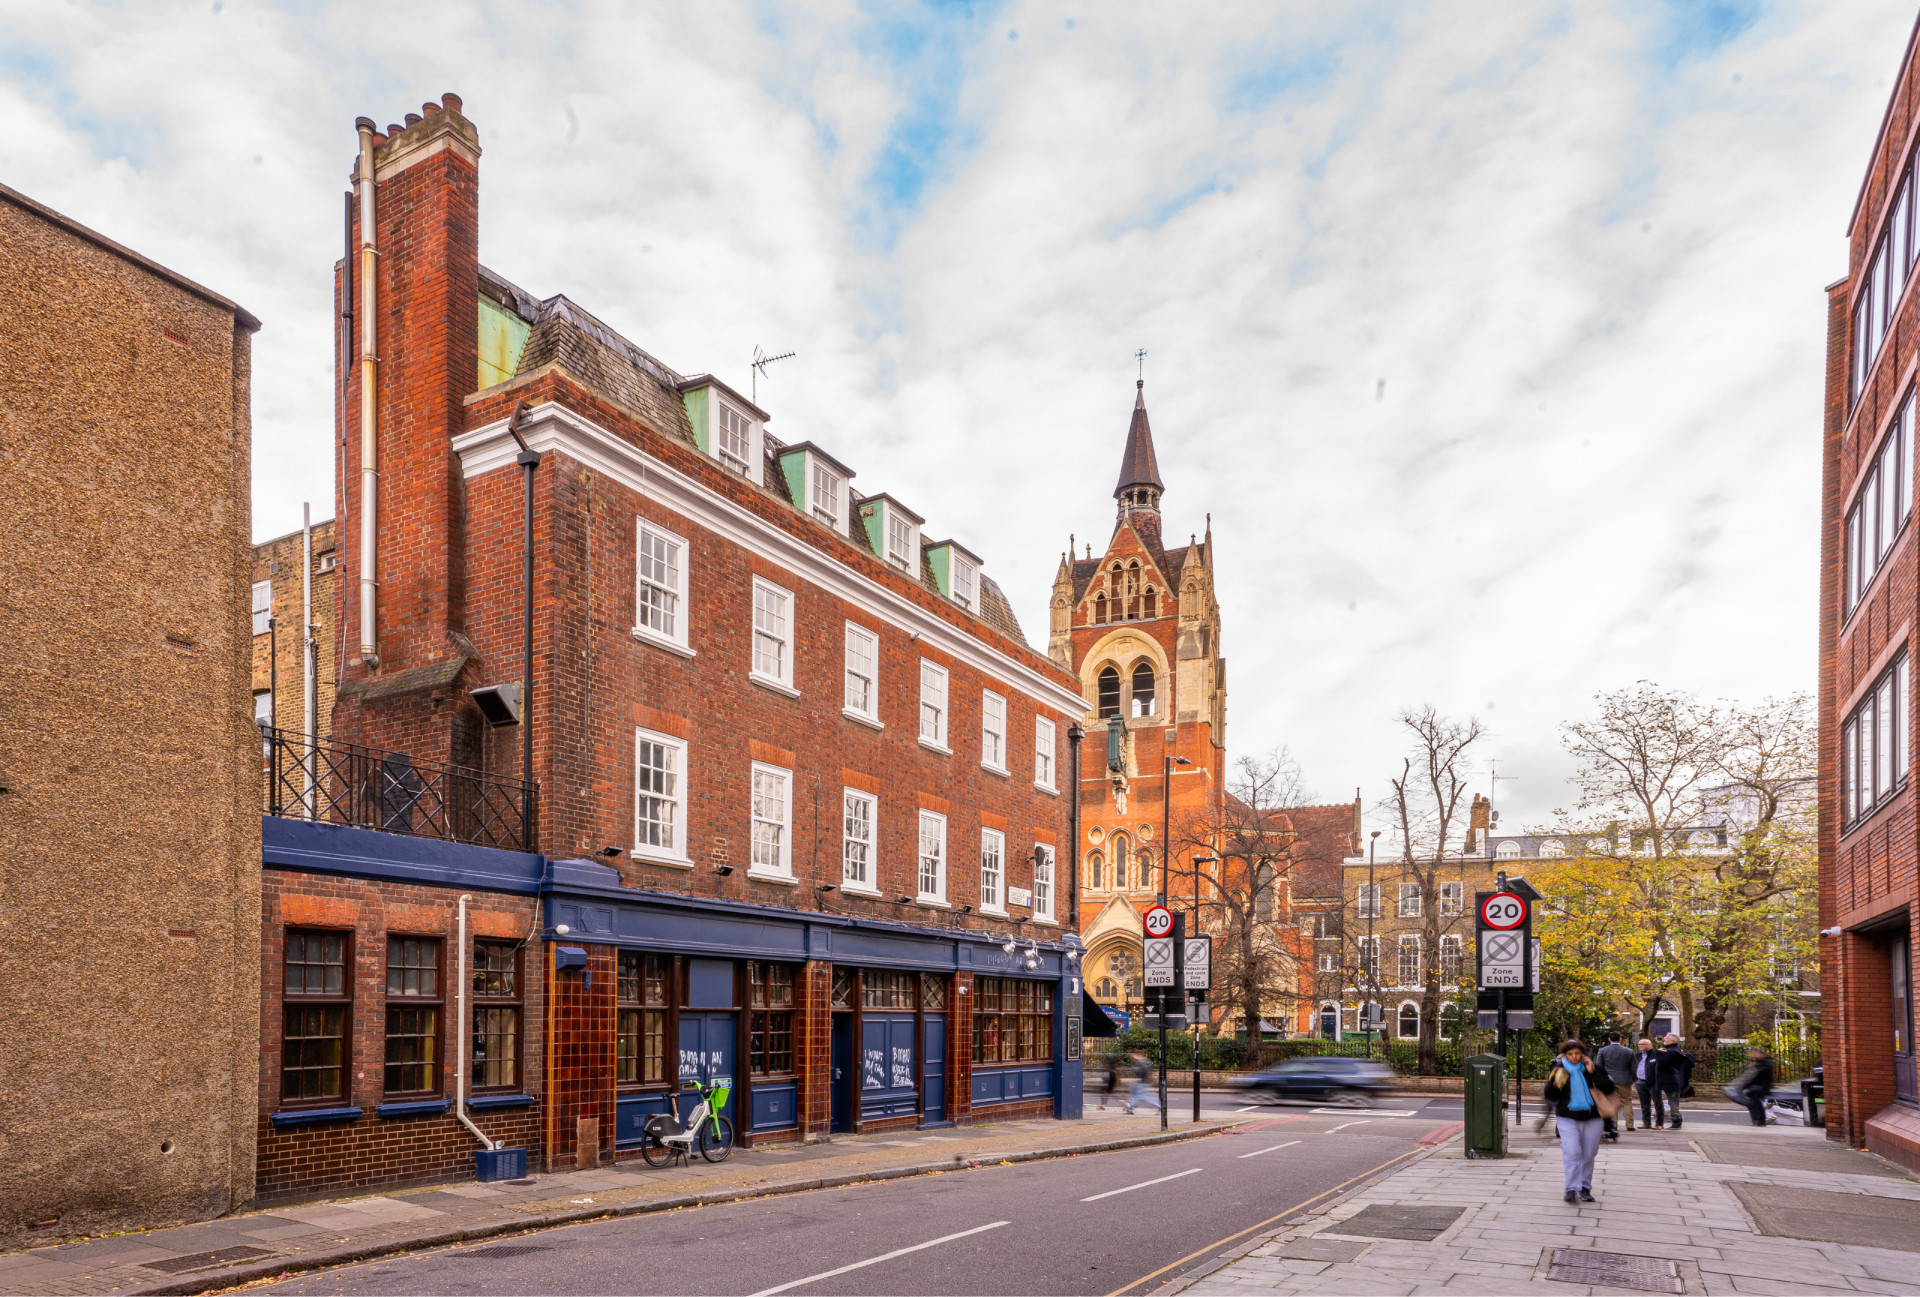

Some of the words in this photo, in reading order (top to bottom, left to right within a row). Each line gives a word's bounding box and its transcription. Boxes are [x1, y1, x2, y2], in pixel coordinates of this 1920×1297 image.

[1488, 903, 1519, 919] 20
[1148, 915, 1169, 928] 20
[1147, 976, 1171, 984] ENDS
[1486, 976, 1519, 984] ENDS
